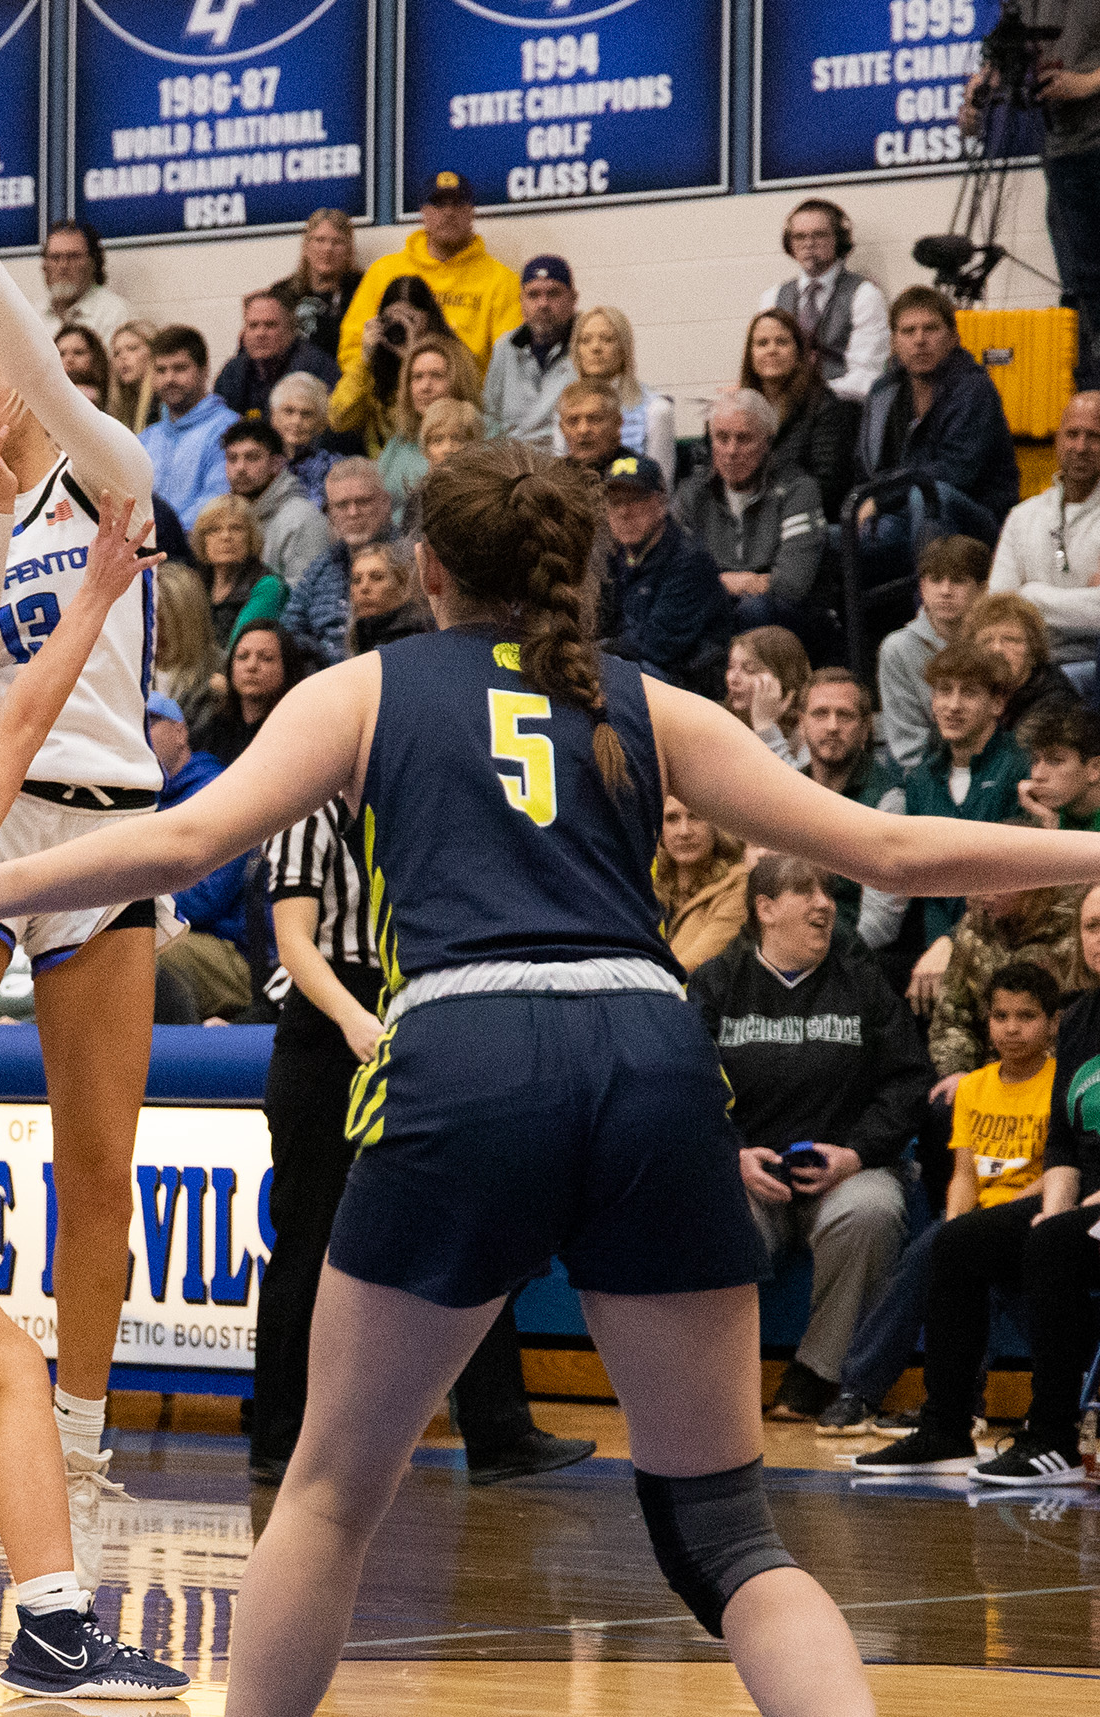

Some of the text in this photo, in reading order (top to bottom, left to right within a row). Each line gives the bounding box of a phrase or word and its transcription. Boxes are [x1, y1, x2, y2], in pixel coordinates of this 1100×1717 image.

[891, 0, 975, 40] 1995
[522, 34, 599, 80] 1994
[813, 53, 891, 90] STATE
[159, 68, 280, 116] 1986-87
[451, 75, 671, 127] STATE CHAMPIONS
[898, 85, 964, 122] GOLF
[113, 111, 326, 159] WORLD & NATIONAL
[528, 123, 591, 158] GOLF
[876, 127, 961, 165] CLASS
[85, 146, 360, 198] GRAND CHAMPION CHEER
[508, 161, 608, 198] CLASS C
[185, 195, 245, 226] USCA
[4, 546, 88, 590] FENTO
[488, 688, 557, 827] 5
[9, 1119, 39, 1142] OF
[118, 1319, 166, 1347] ETIC
[174, 1322, 257, 1352] BOOSTE
